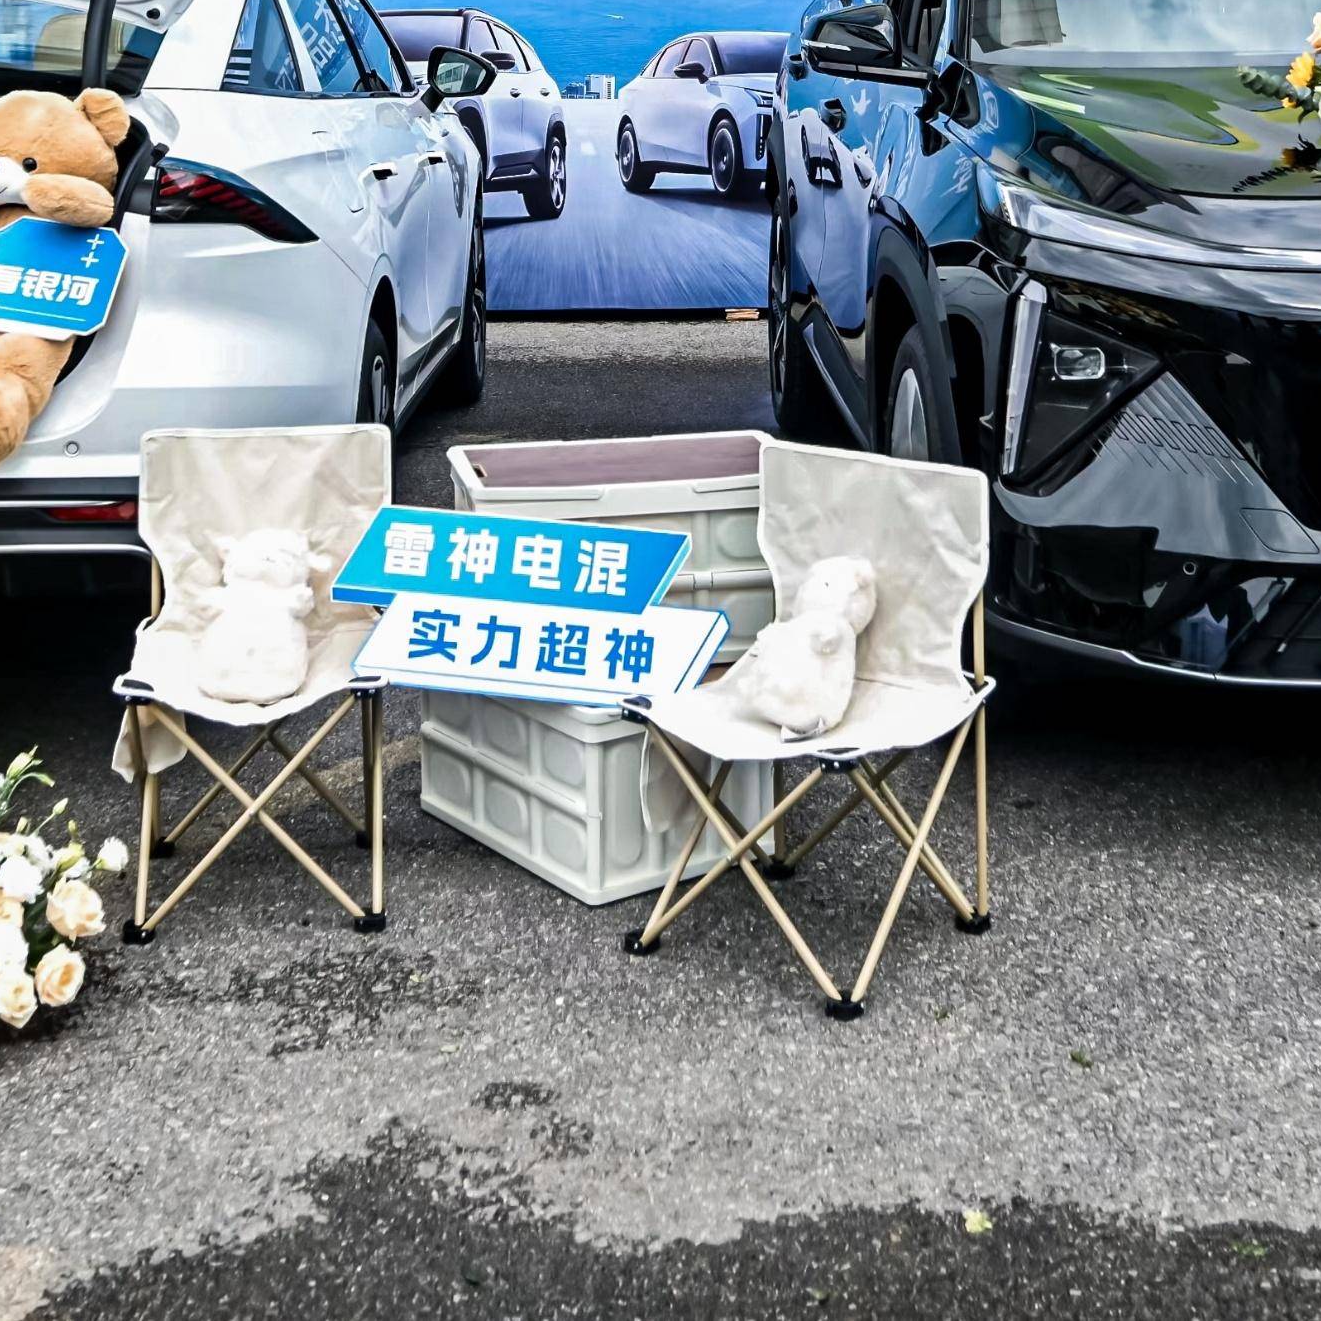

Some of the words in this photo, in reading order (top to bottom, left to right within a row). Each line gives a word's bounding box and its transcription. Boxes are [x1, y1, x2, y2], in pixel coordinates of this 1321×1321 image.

[382, 521, 630, 597] 雷神电混
[407, 608, 655, 683] 实力超神
